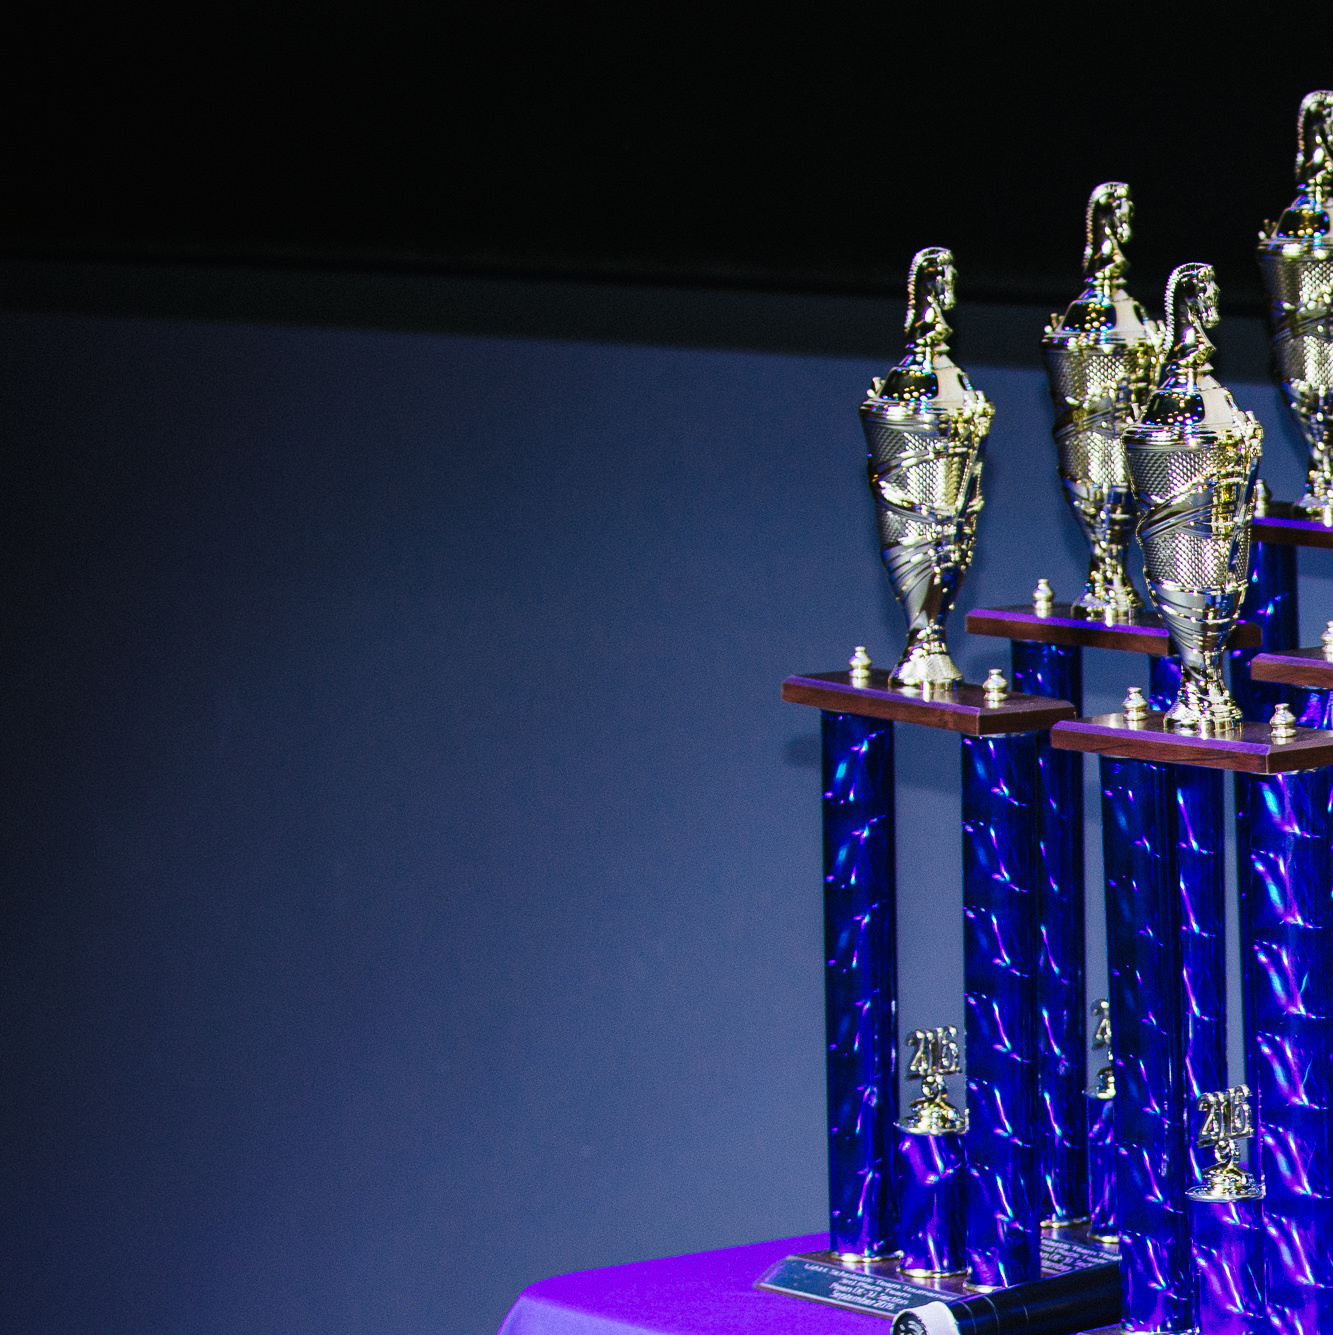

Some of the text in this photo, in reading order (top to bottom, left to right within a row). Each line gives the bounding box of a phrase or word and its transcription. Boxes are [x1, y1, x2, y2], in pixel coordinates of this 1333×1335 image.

[803, 1264, 828, 1272] UAH
[829, 1269, 874, 1282] Scholastic
[875, 1280, 901, 1288] Team
[856, 1282, 883, 1290] Place
[884, 1288, 912, 1296] Team
[829, 1290, 876, 1306] September
[878, 1293, 909, 1304] Section
